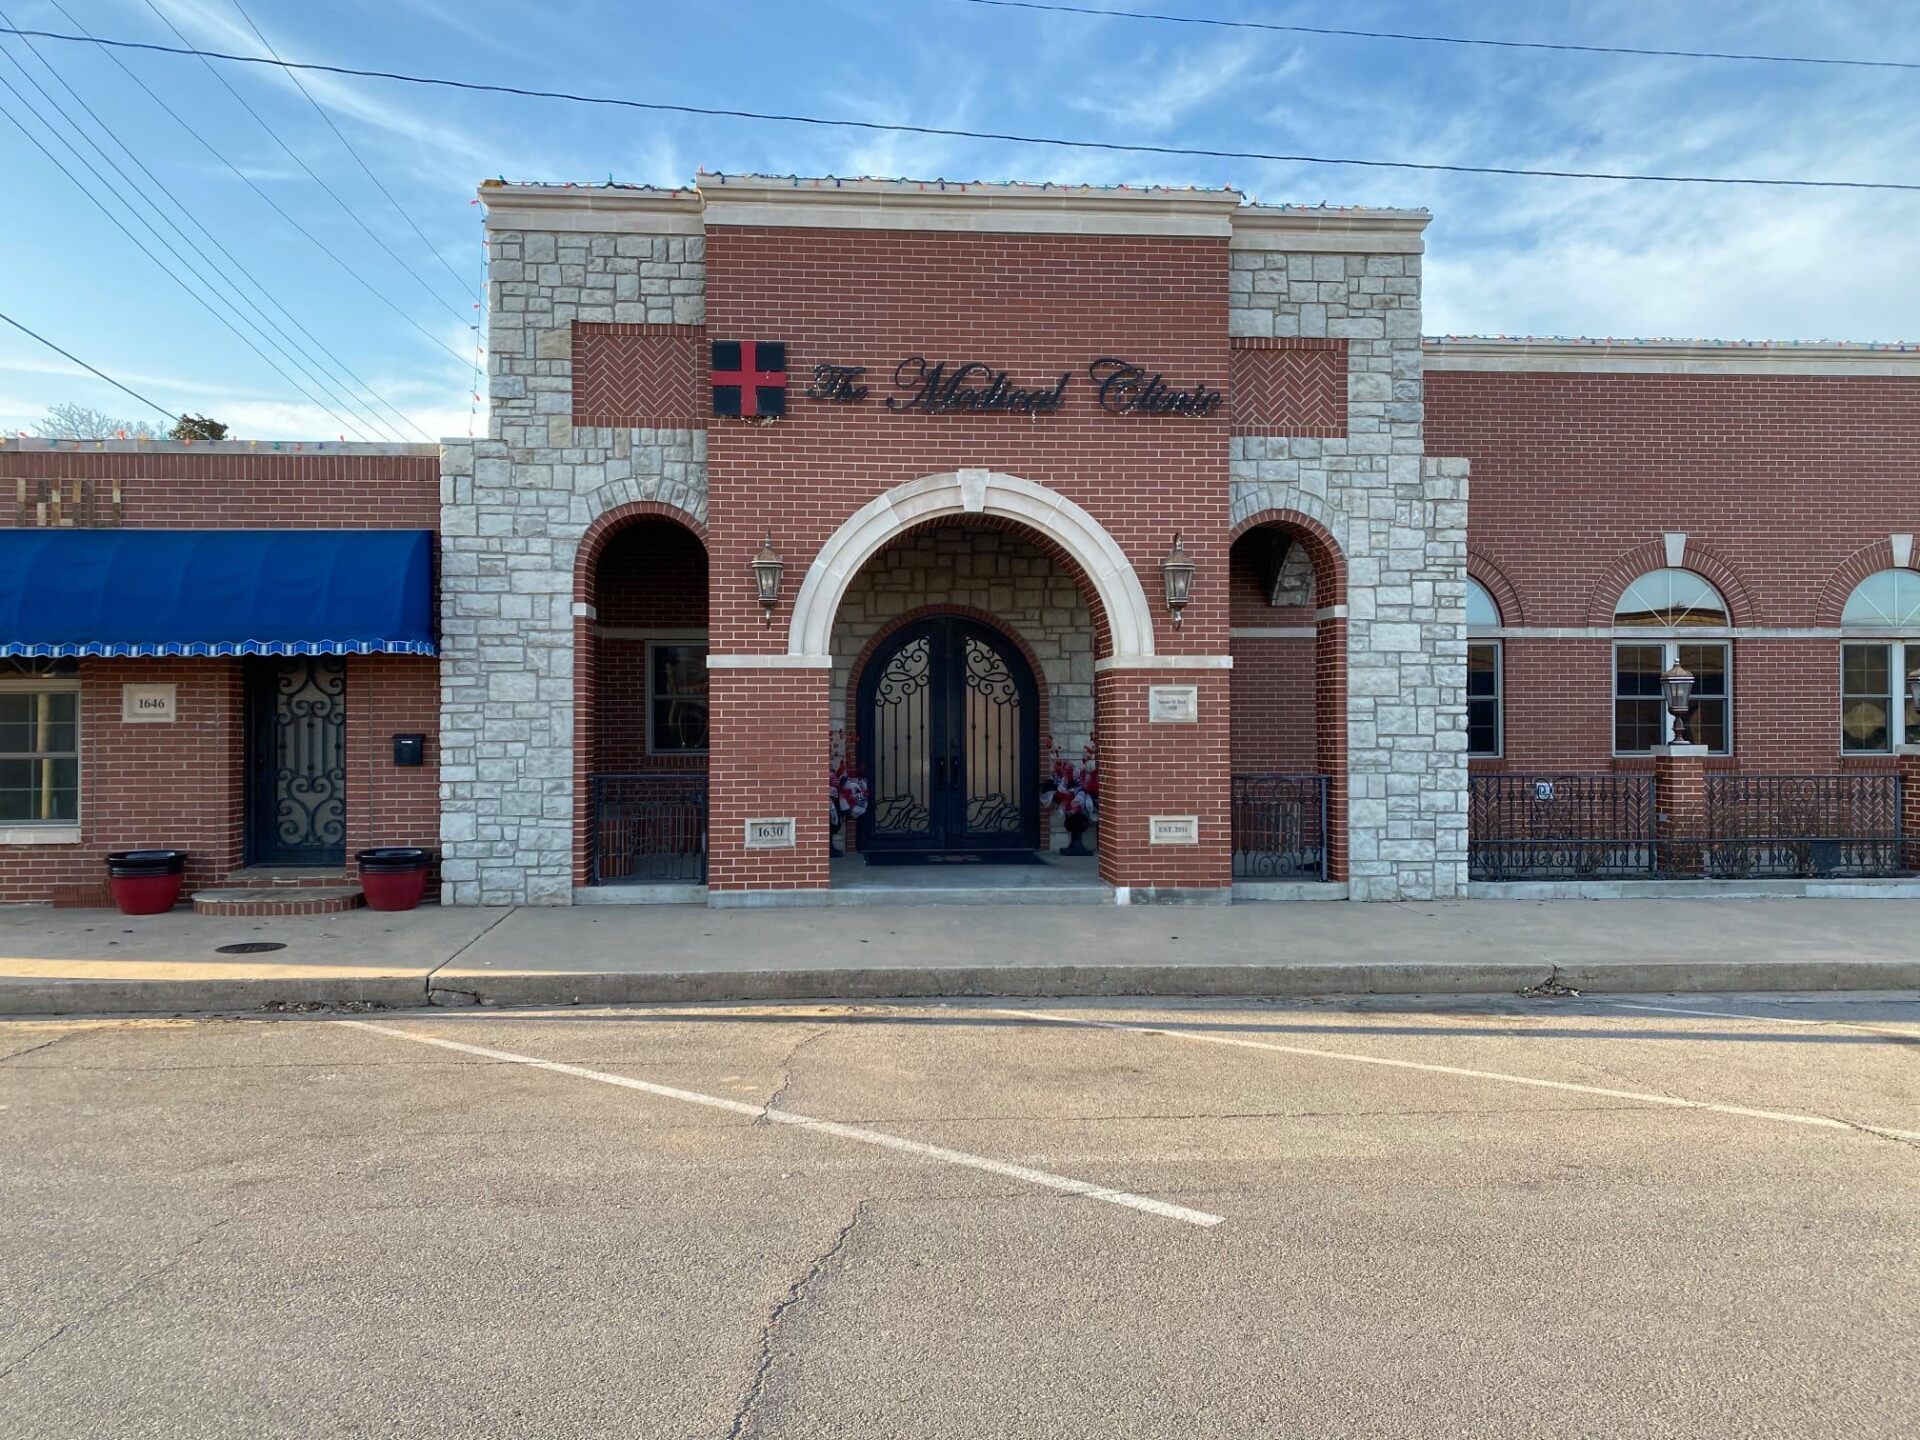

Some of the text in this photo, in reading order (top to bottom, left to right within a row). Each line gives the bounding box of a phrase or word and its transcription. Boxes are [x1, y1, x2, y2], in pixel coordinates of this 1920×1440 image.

[805, 356, 1222, 415] The Medical Clinic
[139, 698, 165, 709] 1646
[758, 826, 783, 837] 1630
